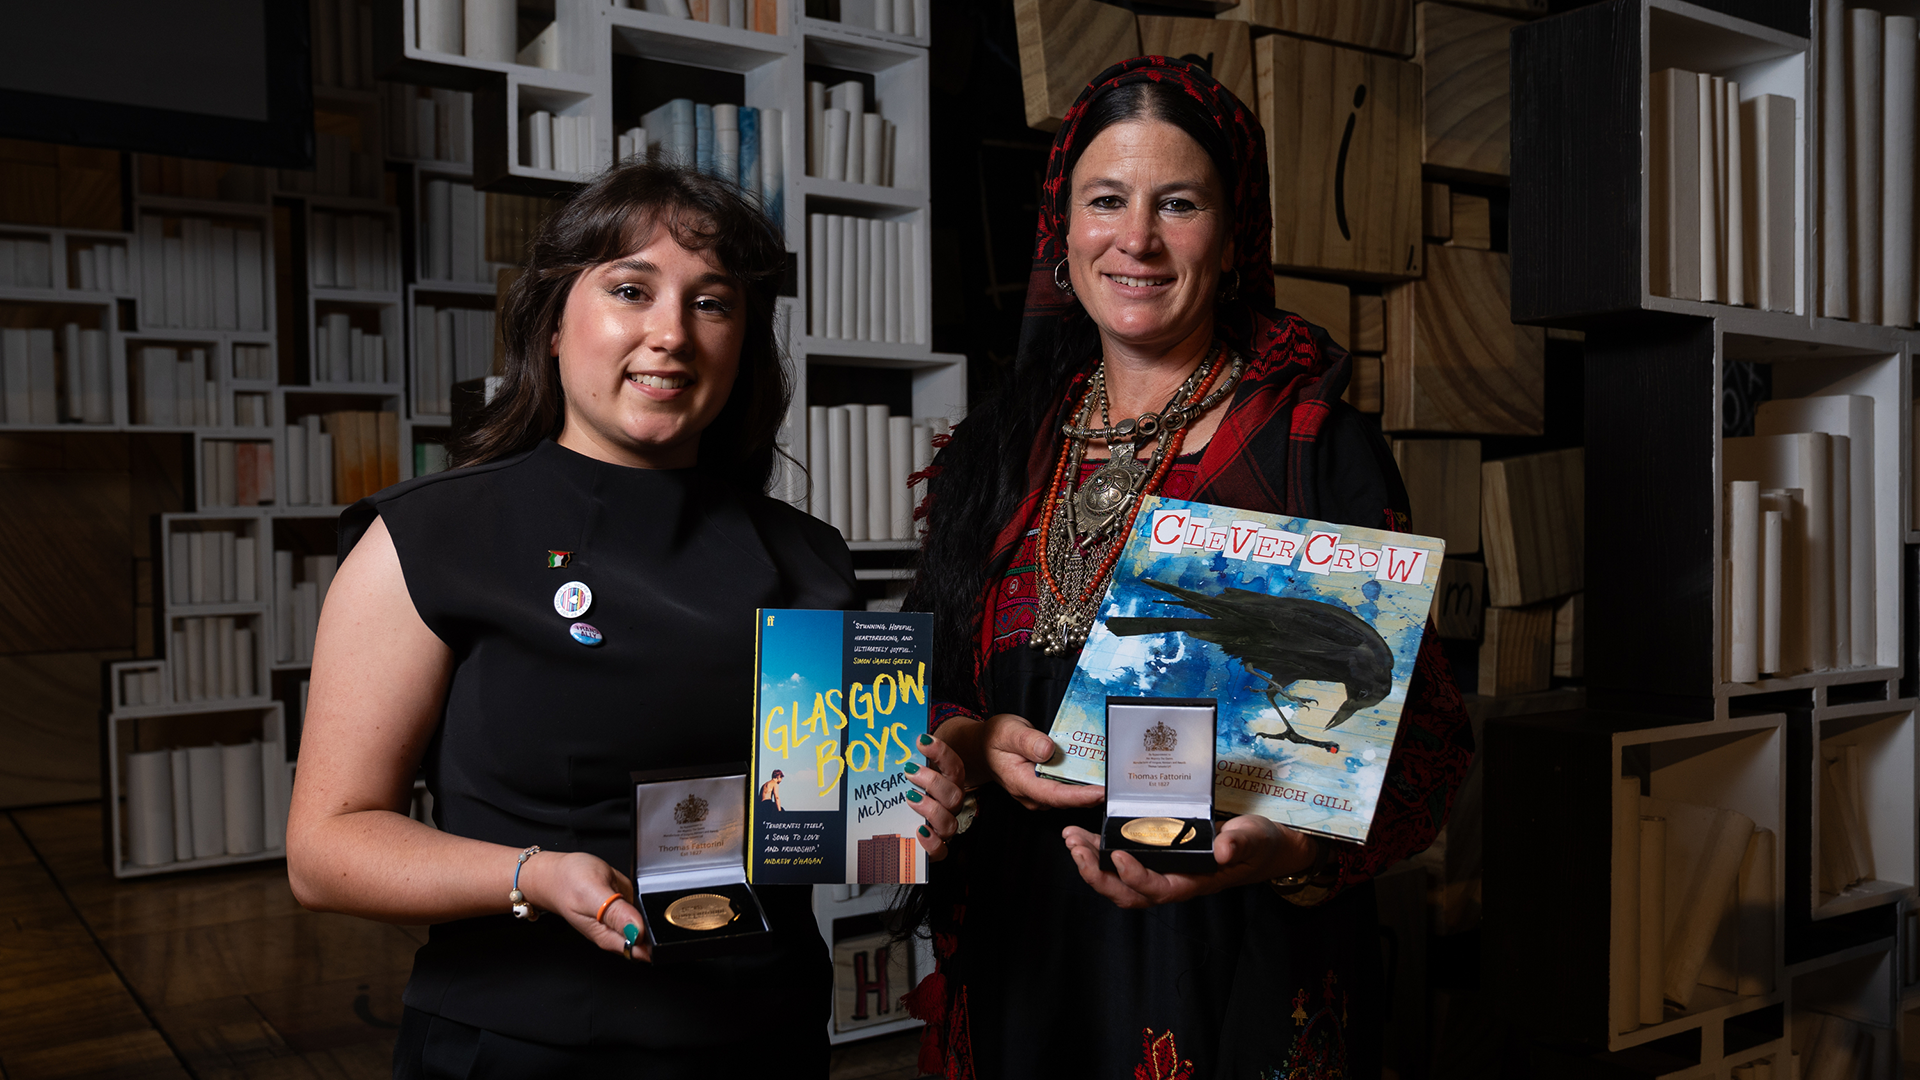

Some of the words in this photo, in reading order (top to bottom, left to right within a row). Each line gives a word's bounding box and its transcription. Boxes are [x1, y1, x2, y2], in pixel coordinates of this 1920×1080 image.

[1154, 514, 1297, 559] CLEVER
[1305, 534, 1423, 583] CROW
[763, 661, 926, 760] GLASGOW
[1072, 730, 1106, 747] CHR
[815, 722, 912, 797] BOYS
[1065, 743, 1107, 762] BUTT
[1127, 772, 1158, 780] Thomas
[1159, 772, 1192, 780] Fattorini
[1217, 759, 1275, 782] OLIVIA
[1313, 793, 1353, 812] GILL
[658, 844, 690, 853] Thomas
[691, 840, 725, 850] Fattorini
[772, 833, 790, 842] SONG
[793, 833, 801, 841] TO
[764, 845, 780, 853] AND
[763, 857, 792, 865] ANDREW
[851, 946, 890, 1020] H
